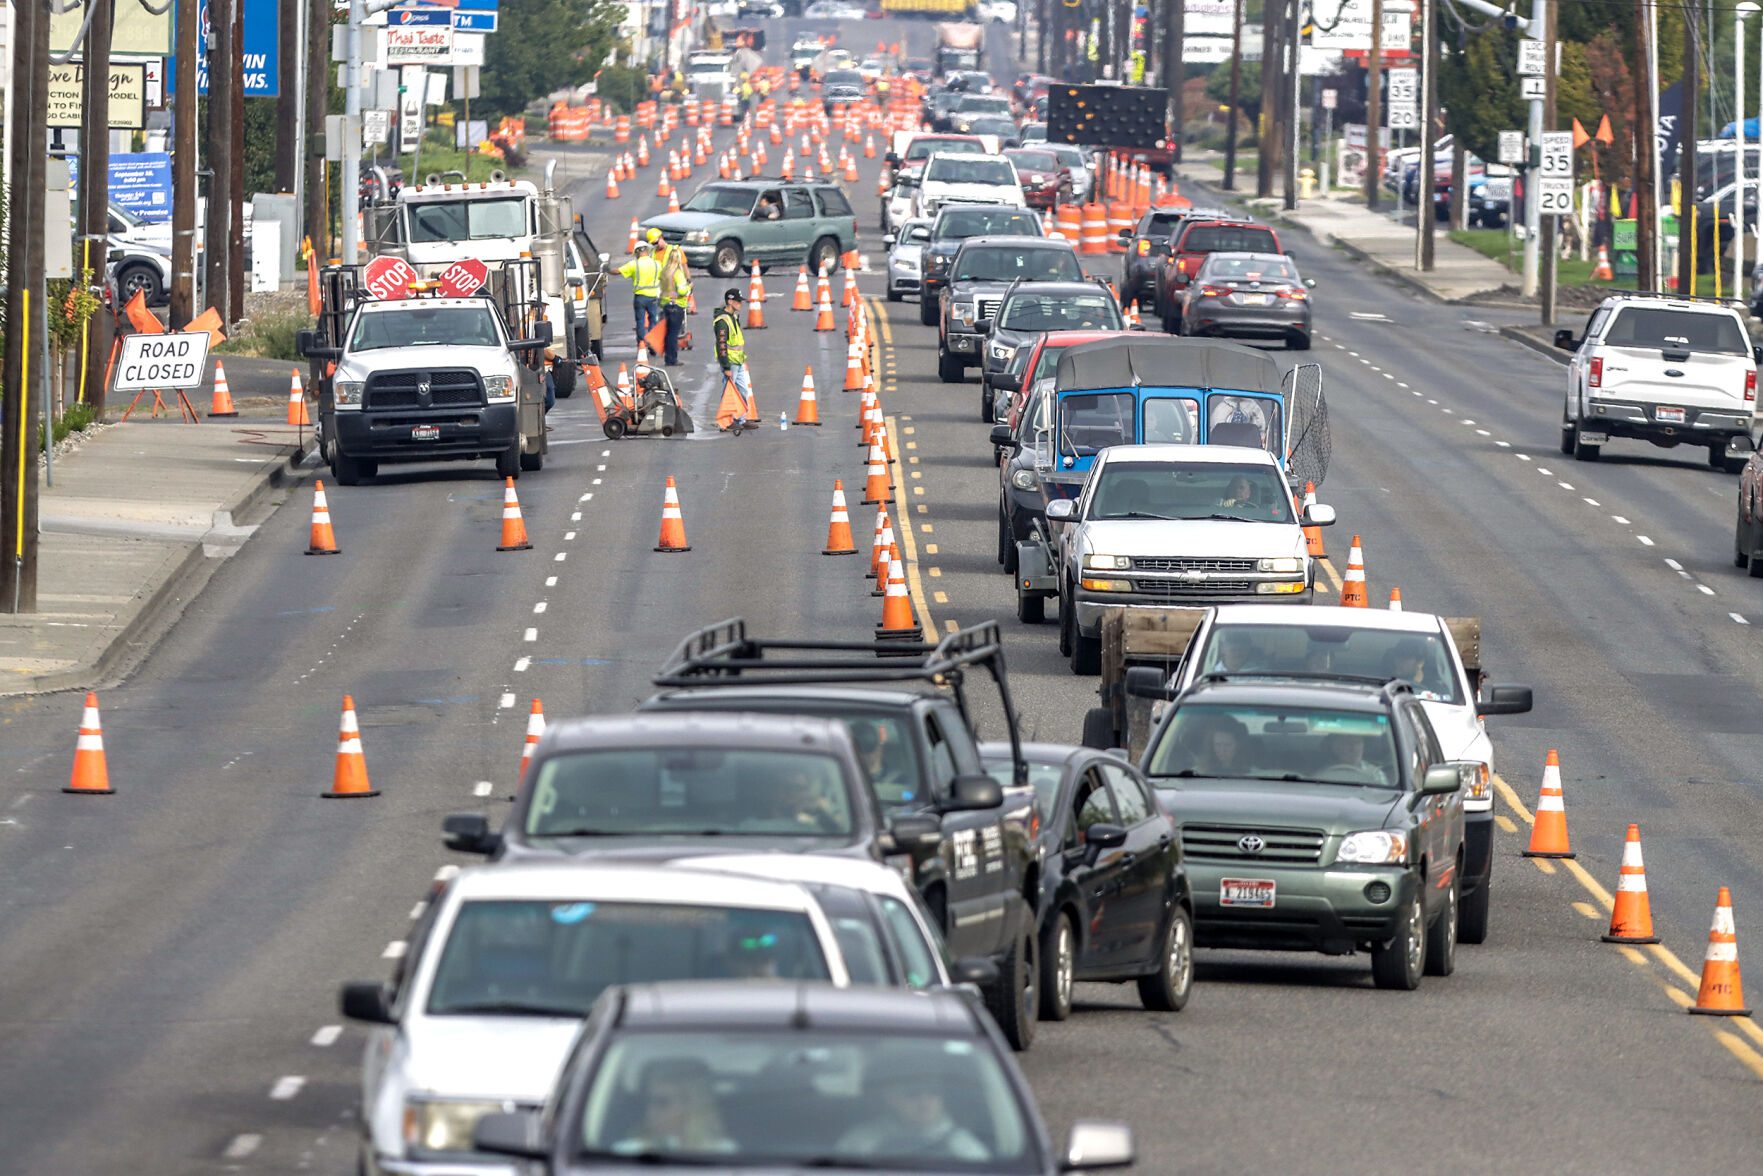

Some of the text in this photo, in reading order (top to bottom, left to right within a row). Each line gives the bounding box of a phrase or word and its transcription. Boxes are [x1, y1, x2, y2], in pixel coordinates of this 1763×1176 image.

[454, 16, 472, 27] TM
[388, 29, 445, 45] Thai Taste
[1525, 63, 1546, 72] ROUT
[1391, 85, 1414, 98] 35
[1391, 112, 1412, 124] 20
[1544, 136, 1570, 144] SPEED
[1544, 155, 1569, 171] 35
[1542, 192, 1570, 209] 20
[370, 261, 409, 299] STOP
[444, 265, 481, 293] STOP
[139, 340, 190, 359] ROAD
[125, 363, 195, 381] CLOSED
[1344, 593, 1361, 601] PTC
